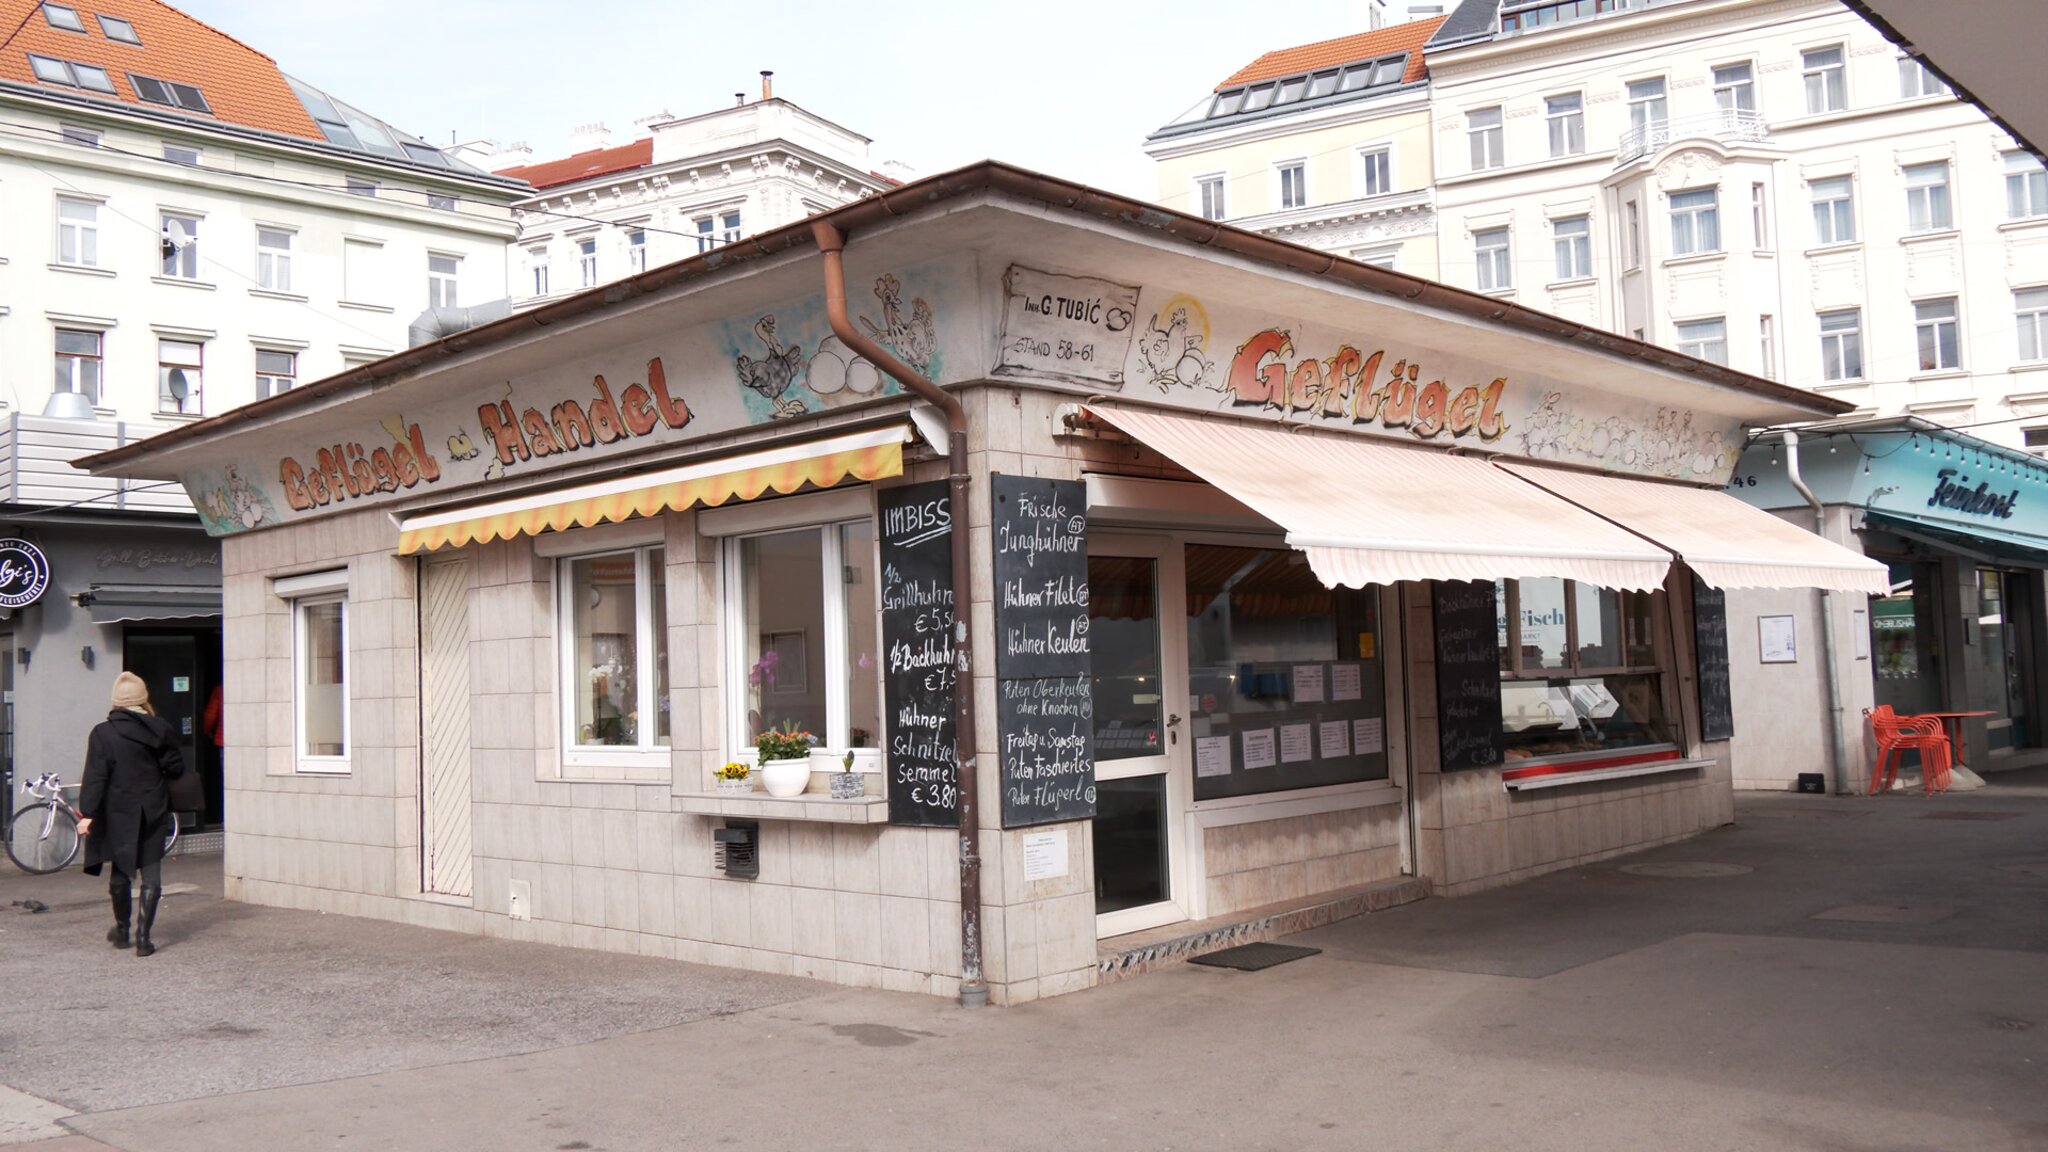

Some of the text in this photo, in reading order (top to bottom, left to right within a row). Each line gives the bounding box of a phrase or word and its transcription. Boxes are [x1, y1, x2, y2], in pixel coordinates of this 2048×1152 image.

[1013, 337, 1094, 361] STAND 58-61
[1227, 327, 1510, 443] Geflügel
[281, 356, 693, 511] Geflügel Handel
[1018, 490, 1068, 519] Frische
[1928, 468, 2019, 519] Feinkost
[885, 498, 951, 537] IMBISS
[1000, 520, 1084, 568] Junghühner
[882, 579, 954, 613] Grillhuhn
[1004, 577, 1045, 609] Hühner
[1045, 576, 1077, 606] Filet
[914, 614, 928, 633] €
[1008, 619, 1090, 656] Hühner Keulen
[924, 674, 937, 691] €
[899, 702, 947, 731] Hühner
[1017, 698, 1039, 715] ohne
[1041, 698, 1078, 716] Knochen
[893, 731, 957, 763] Schnitzel
[1006, 723, 1038, 754] Freitag
[1047, 722, 1086, 756] Samstag
[897, 763, 957, 783] Semmel
[1008, 749, 1034, 779] Puten
[911, 787, 924, 803] €
